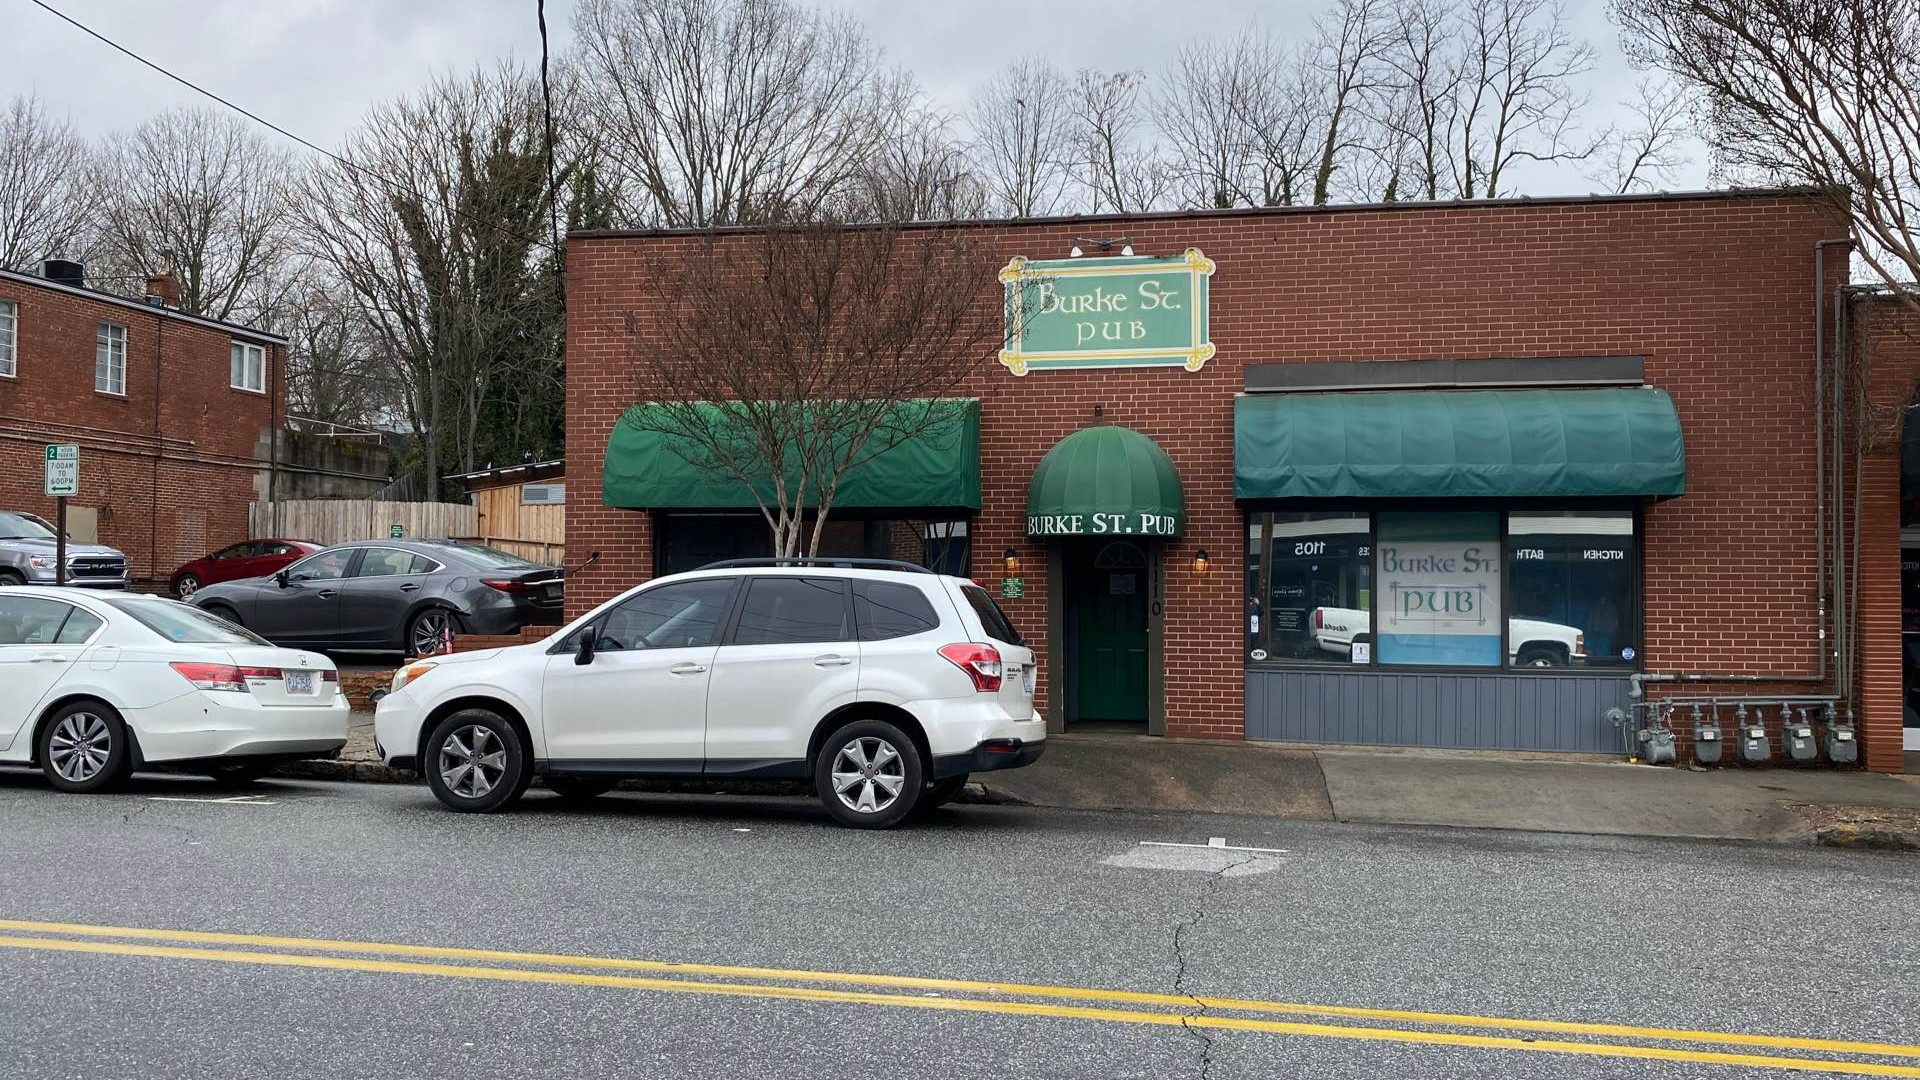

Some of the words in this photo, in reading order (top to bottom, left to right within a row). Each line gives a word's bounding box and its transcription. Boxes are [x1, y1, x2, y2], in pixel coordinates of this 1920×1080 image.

[1039, 282, 1128, 314] Burke
[1138, 280, 1183, 310] St.
[49, 448, 55, 458] 2
[1027, 515, 1084, 535] BURKE
[1092, 512, 1132, 533] ST.
[1140, 513, 1175, 535] PUB
[1380, 547, 1457, 574] Burke
[1462, 547, 1499, 574] St.
